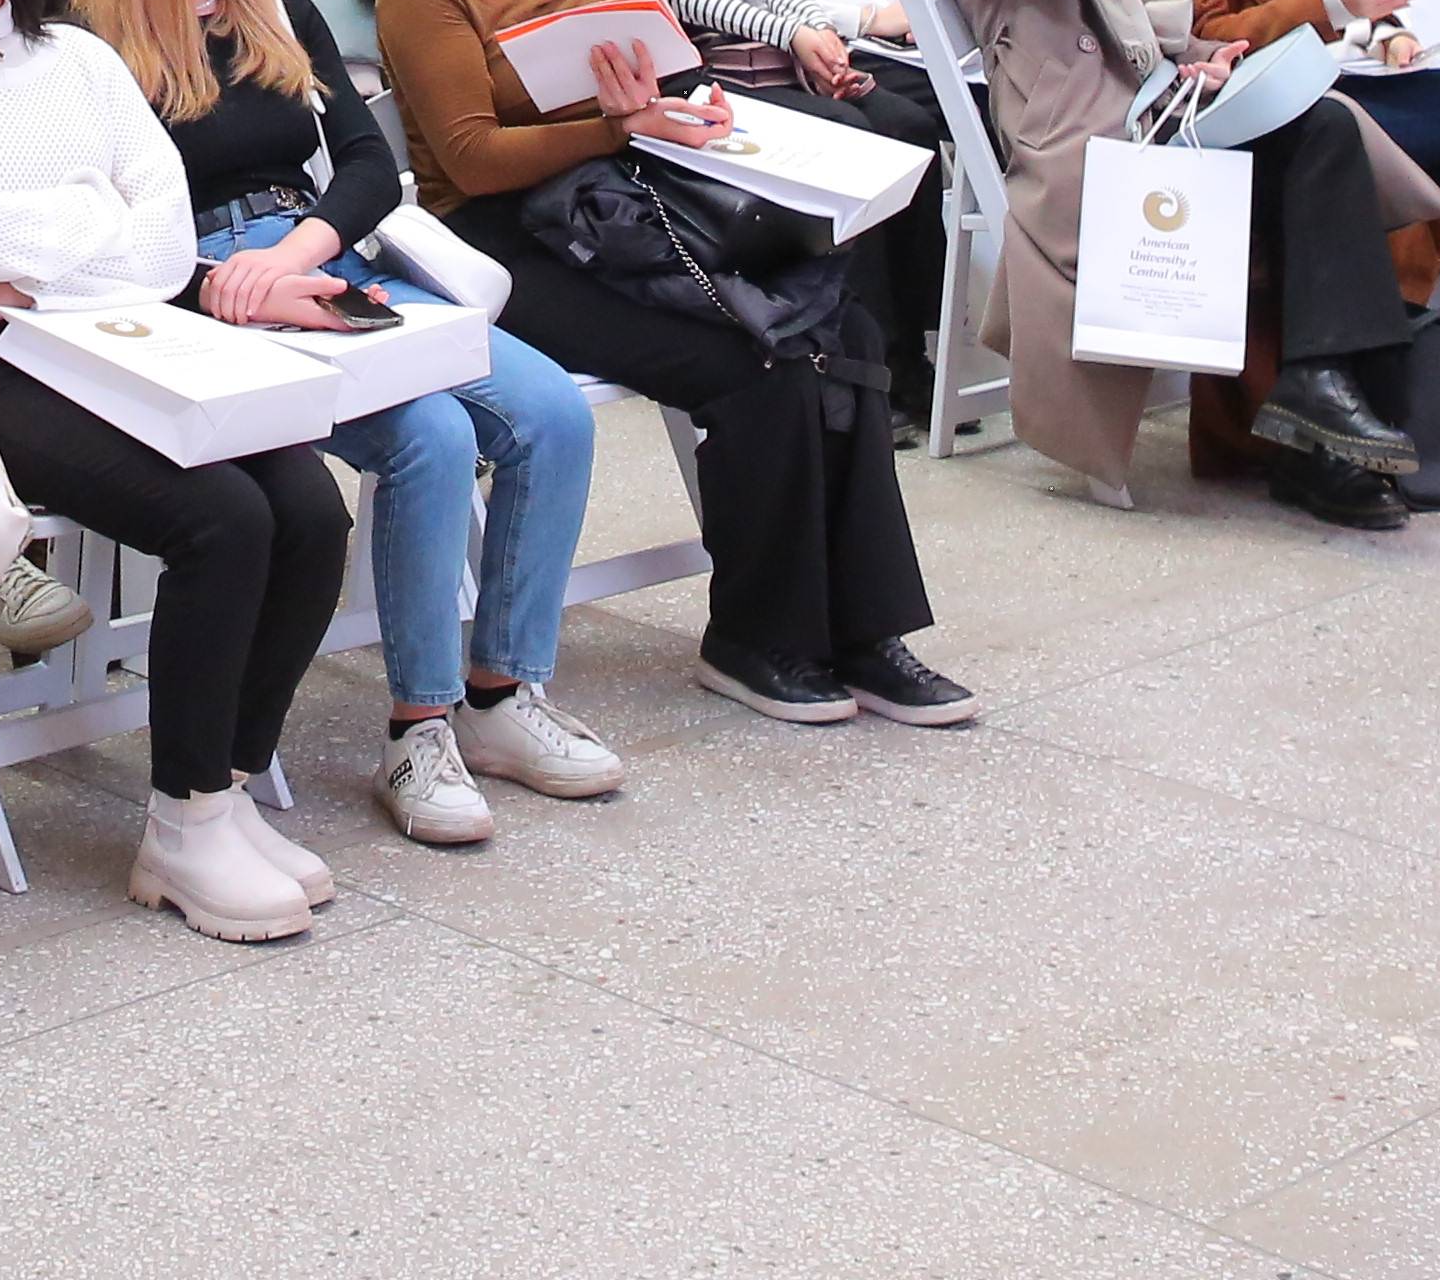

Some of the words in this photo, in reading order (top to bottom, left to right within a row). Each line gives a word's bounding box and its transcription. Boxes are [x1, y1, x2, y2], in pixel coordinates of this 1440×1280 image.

[1138, 236, 1190, 250] American
[1130, 250, 1186, 268] University
[1129, 265, 1169, 279] Central
[1170, 270, 1196, 281] Asia
